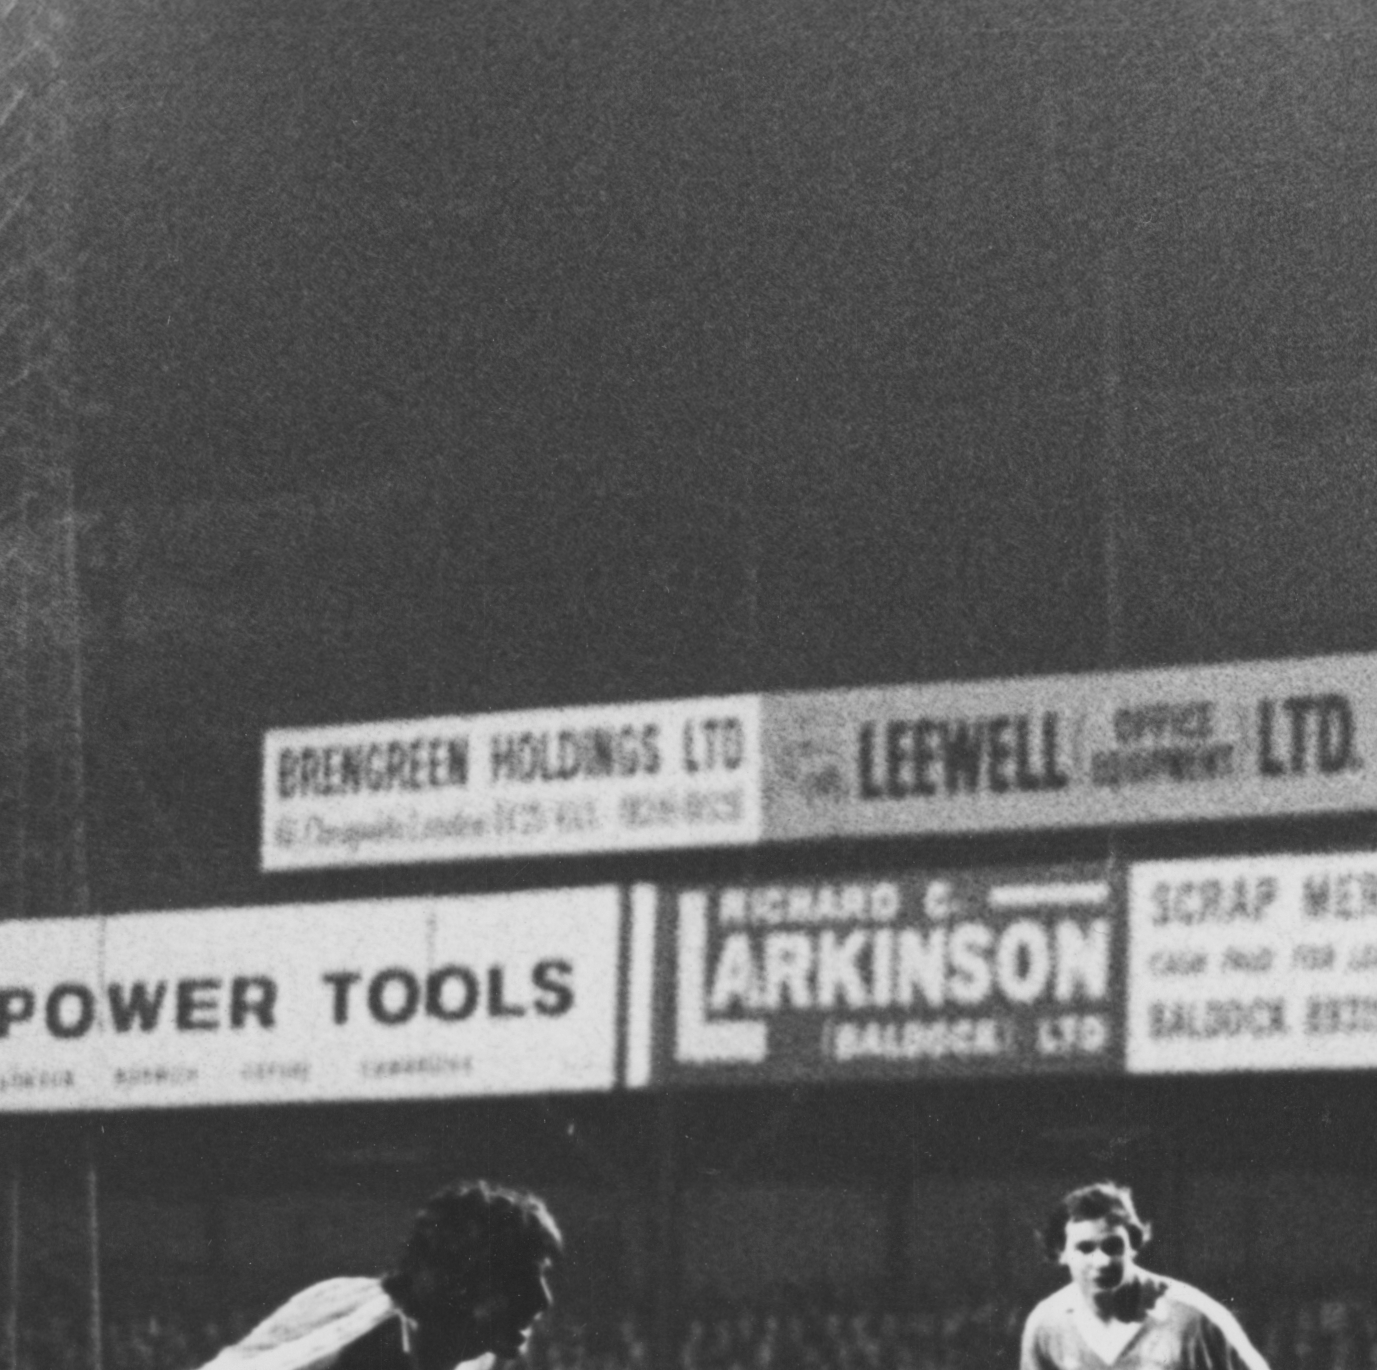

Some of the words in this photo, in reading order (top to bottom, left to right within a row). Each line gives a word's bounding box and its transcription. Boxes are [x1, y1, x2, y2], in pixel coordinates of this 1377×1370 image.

[278, 734, 470, 799] BRENGREEN
[490, 722, 662, 785] HOLDINGS
[683, 716, 746, 775] LTD
[856, 711, 1069, 800] LEEWELL
[718, 880, 900, 926] RICHARD
[1151, 873, 1280, 927] SCRAP
[0, 974, 279, 1041] POWER
[320, 957, 576, 1026] TOOLS
[1148, 996, 1287, 1041] BALDOCK
[1035, 1013, 1108, 1056] LTD
